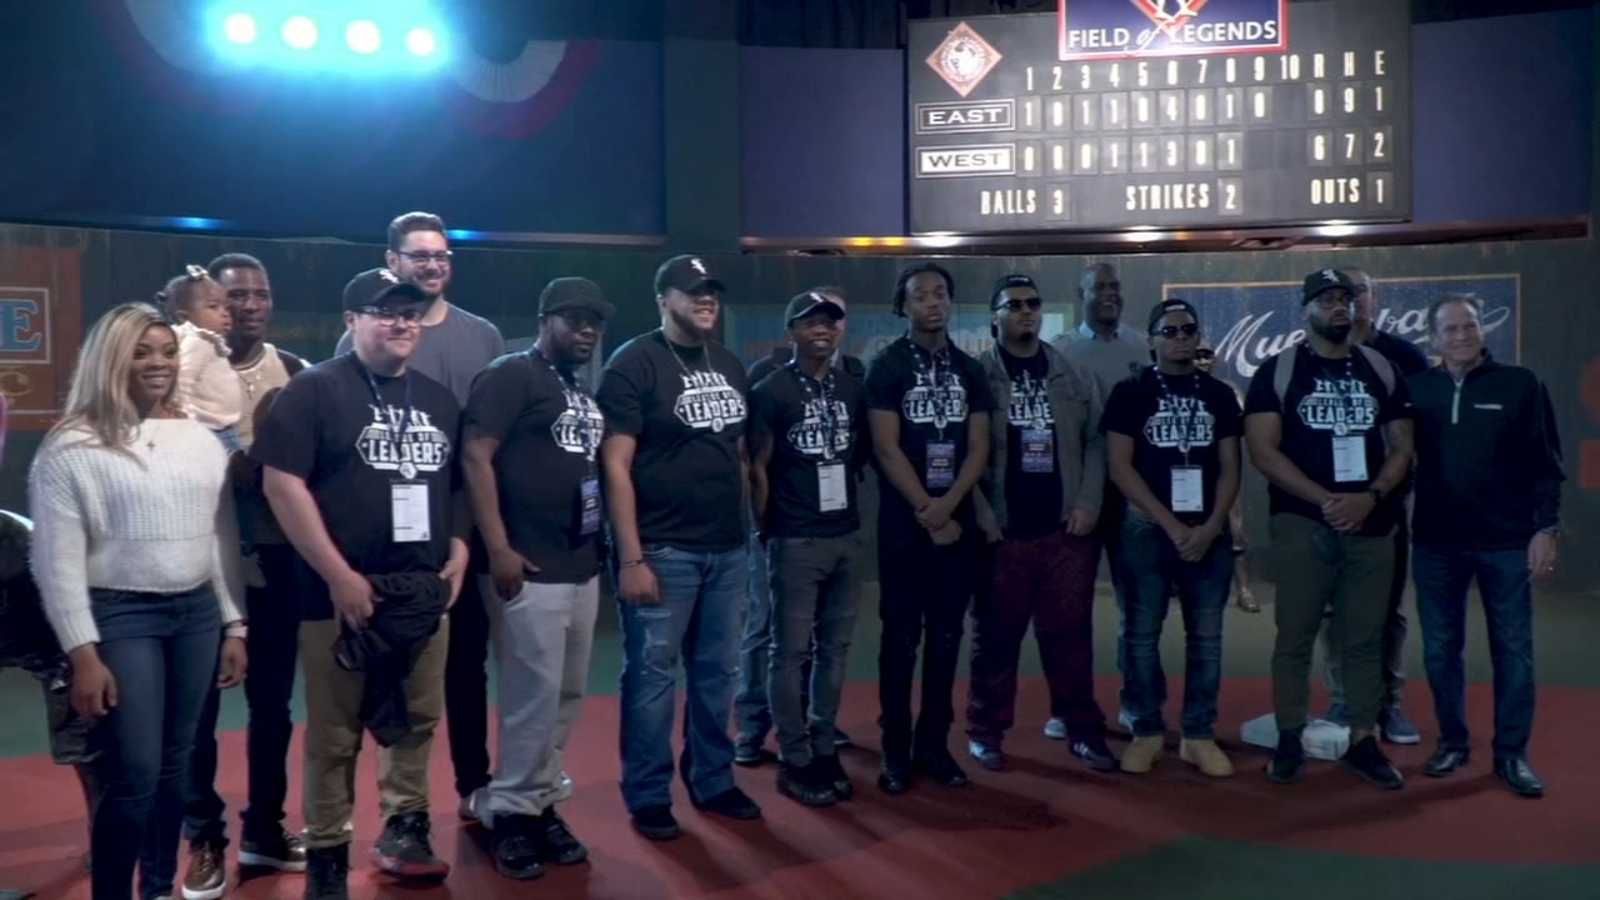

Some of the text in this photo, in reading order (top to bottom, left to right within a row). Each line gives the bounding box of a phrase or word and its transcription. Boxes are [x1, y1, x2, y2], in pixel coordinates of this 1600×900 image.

[1068, 28, 1130, 48] FIELD
[1170, 20, 1276, 44] LEGENDS
[1026, 66, 1034, 91] 1
[1052, 66, 1063, 90] 2
[1081, 64, 1091, 89] 3
[1109, 63, 1120, 88] 4
[1138, 61, 1148, 86] 5
[1197, 59, 1208, 84] 7
[1254, 56, 1265, 81] 9
[1280, 54, 1300, 80] 10
[1313, 53, 1325, 78] R
[1343, 51, 1355, 77] H
[1374, 50, 1386, 75] E
[928, 108, 1003, 125] EAST
[1025, 101, 1032, 126] 1
[1082, 100, 1090, 125] 1
[1110, 99, 1118, 124] 1
[1166, 96, 1177, 121] 4
[1226, 93, 1234, 119] 1
[1344, 87, 1355, 113] 9
[1374, 86, 1383, 111] 1
[928, 152, 1003, 168] WEST
[1110, 143, 1119, 169] 1
[1140, 141, 1148, 168] 1
[1167, 140, 1177, 167] 3
[1227, 139, 1235, 165] 1
[1314, 135, 1325, 161] 6
[1344, 133, 1355, 159] 7
[1374, 132, 1385, 158] 2
[981, 178, 1384, 215] BALLS 3 STRIKES 2 OUTS 1
[684, 399, 747, 422] LEADERS
[909, 399, 966, 417] LEAER
[1008, 402, 1052, 420] LEADE
[1307, 406, 1375, 424] LEADERS
[369, 439, 443, 463] LEADERS
